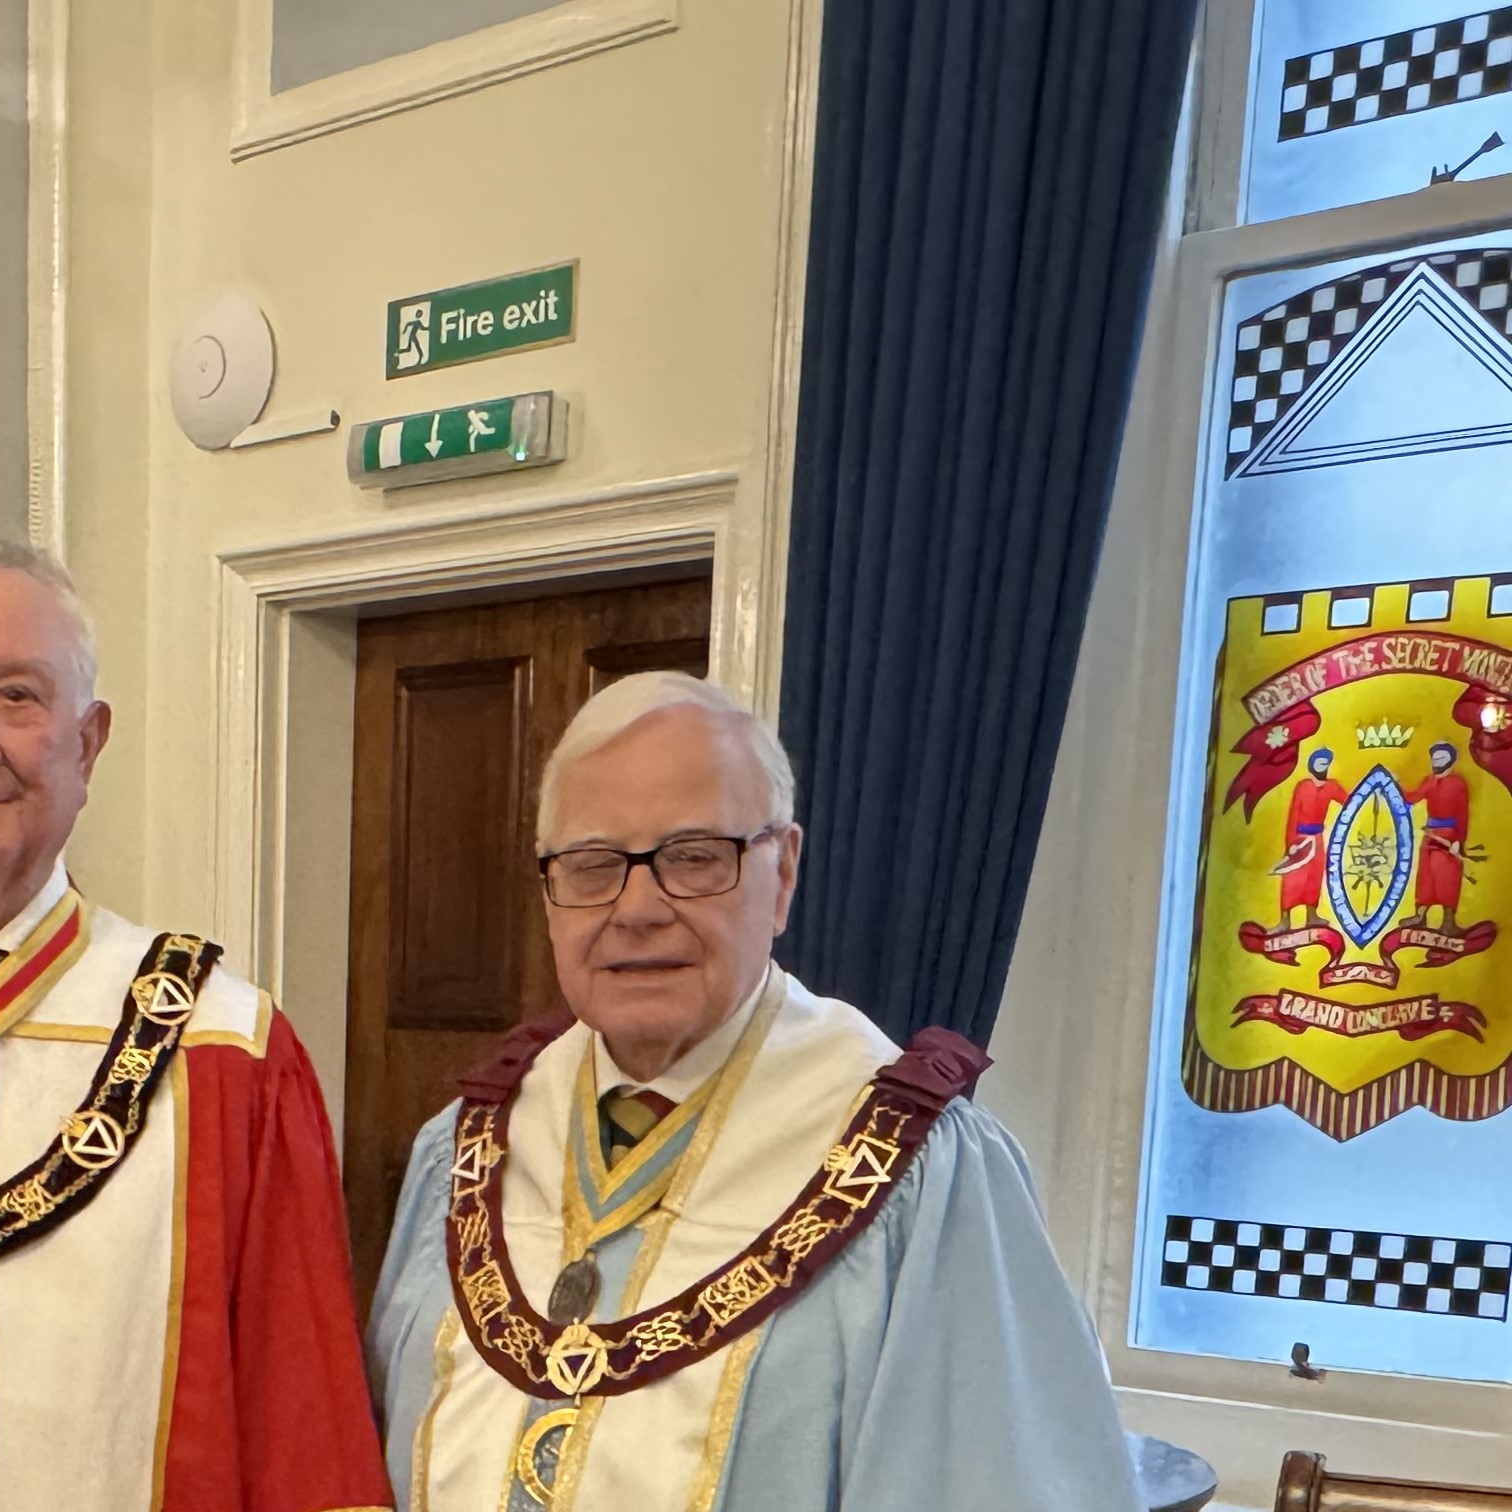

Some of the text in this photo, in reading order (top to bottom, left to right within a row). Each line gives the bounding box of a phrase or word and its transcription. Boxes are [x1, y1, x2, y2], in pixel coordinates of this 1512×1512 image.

[440, 289, 558, 344] Fire exit
[1250, 674, 1308, 724] ORDER
[1303, 658, 1327, 691] OF
[1332, 641, 1380, 679] THE
[1382, 637, 1460, 672] SECRET
[1279, 993, 1436, 1034] GRAND CONCLAVE
